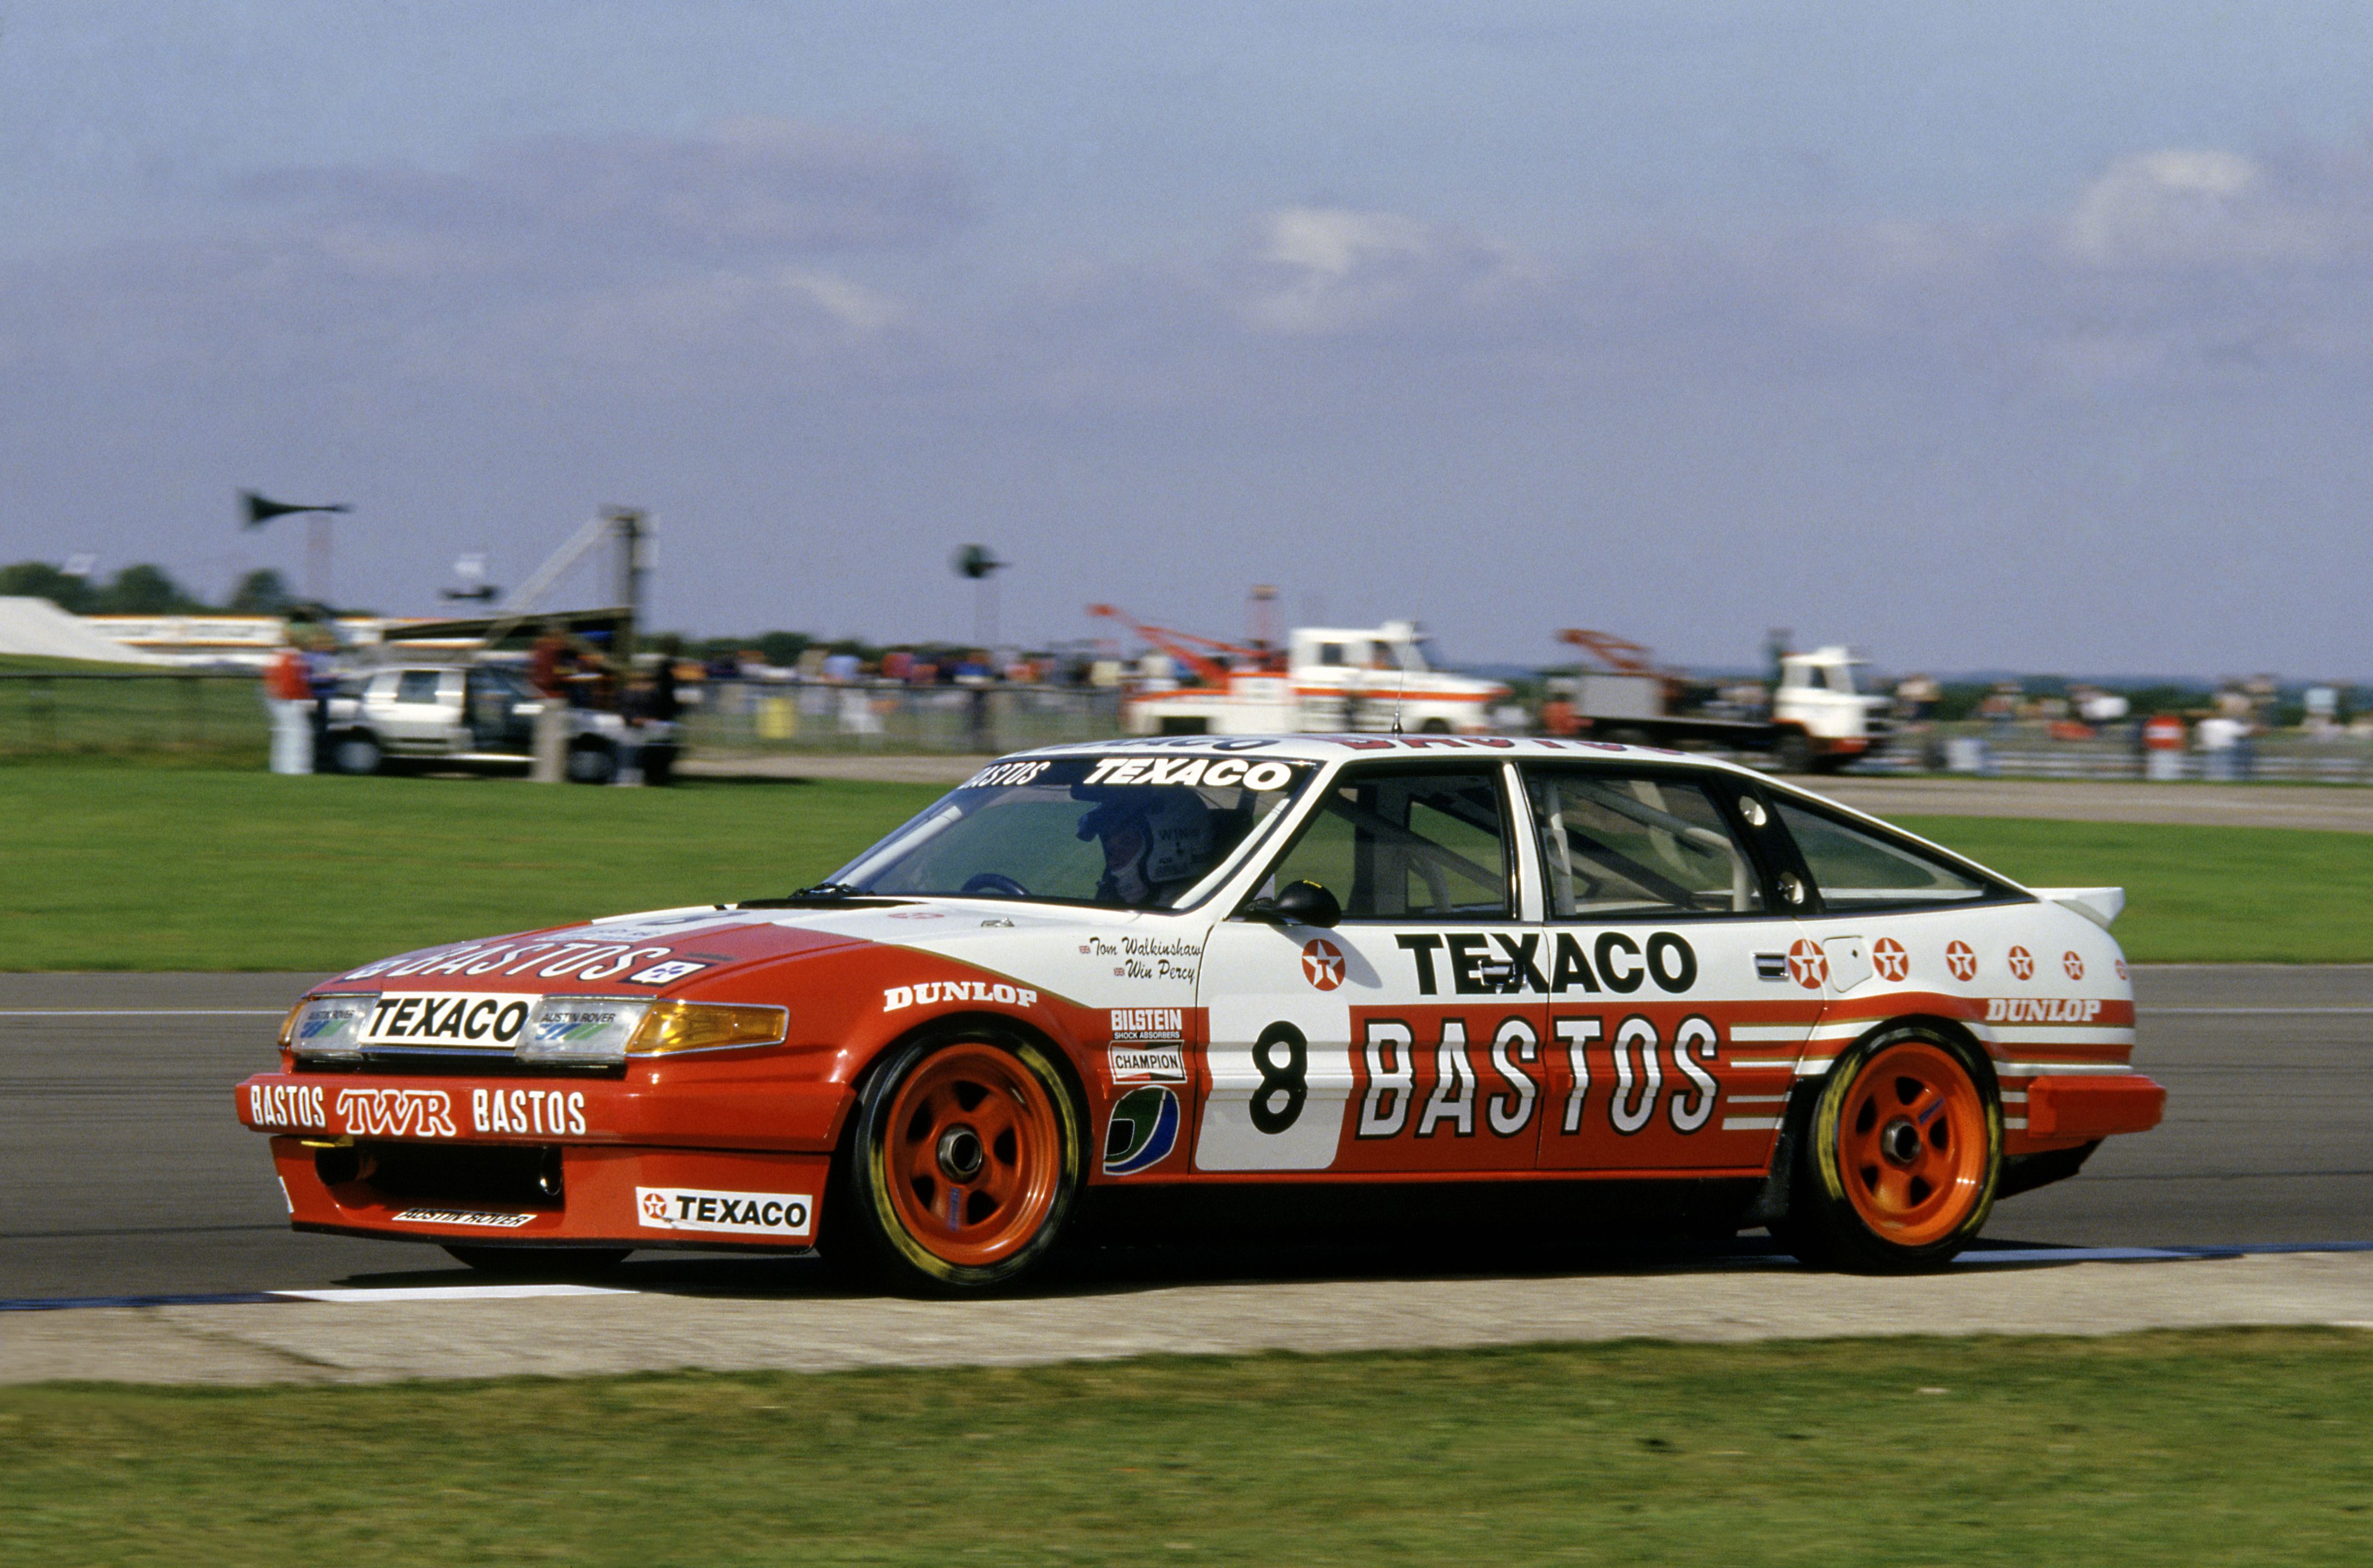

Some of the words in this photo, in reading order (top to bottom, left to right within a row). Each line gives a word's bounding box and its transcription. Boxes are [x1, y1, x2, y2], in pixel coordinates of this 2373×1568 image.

[957, 761, 1051, 789] ASTOS
[1084, 758, 1292, 791] TEXACO
[1090, 936, 1117, 956] Tom
[1122, 936, 1201, 957] Walkinshaw
[384, 944, 673, 981] BASTOS
[1126, 959, 1152, 978] Win
[1158, 959, 1195, 985] Percy
[1395, 931, 1698, 995] TEXACO
[883, 982, 1037, 1012] DUNLOP
[1985, 999, 2101, 1021] DUNLOP
[369, 998, 529, 1042] TEXACO
[540, 1013, 580, 1022] AUSTIN
[580, 1013, 616, 1022] ROVER
[1111, 1009, 1182, 1031] BILSTEIN
[1139, 1031, 1181, 1039] ABSORBERS
[1115, 1055, 1179, 1068] CHAMPION
[1355, 1013, 1720, 1140] BASTOS
[1250, 1020, 1307, 1135] 8
[250, 1085, 326, 1128] BASTOS
[336, 1088, 457, 1137] TWR
[472, 1089, 586, 1135] BASTOS
[397, 1208, 467, 1222] AUSTIN
[462, 1211, 528, 1225] ROVER
[676, 1196, 808, 1228] TEXACO
